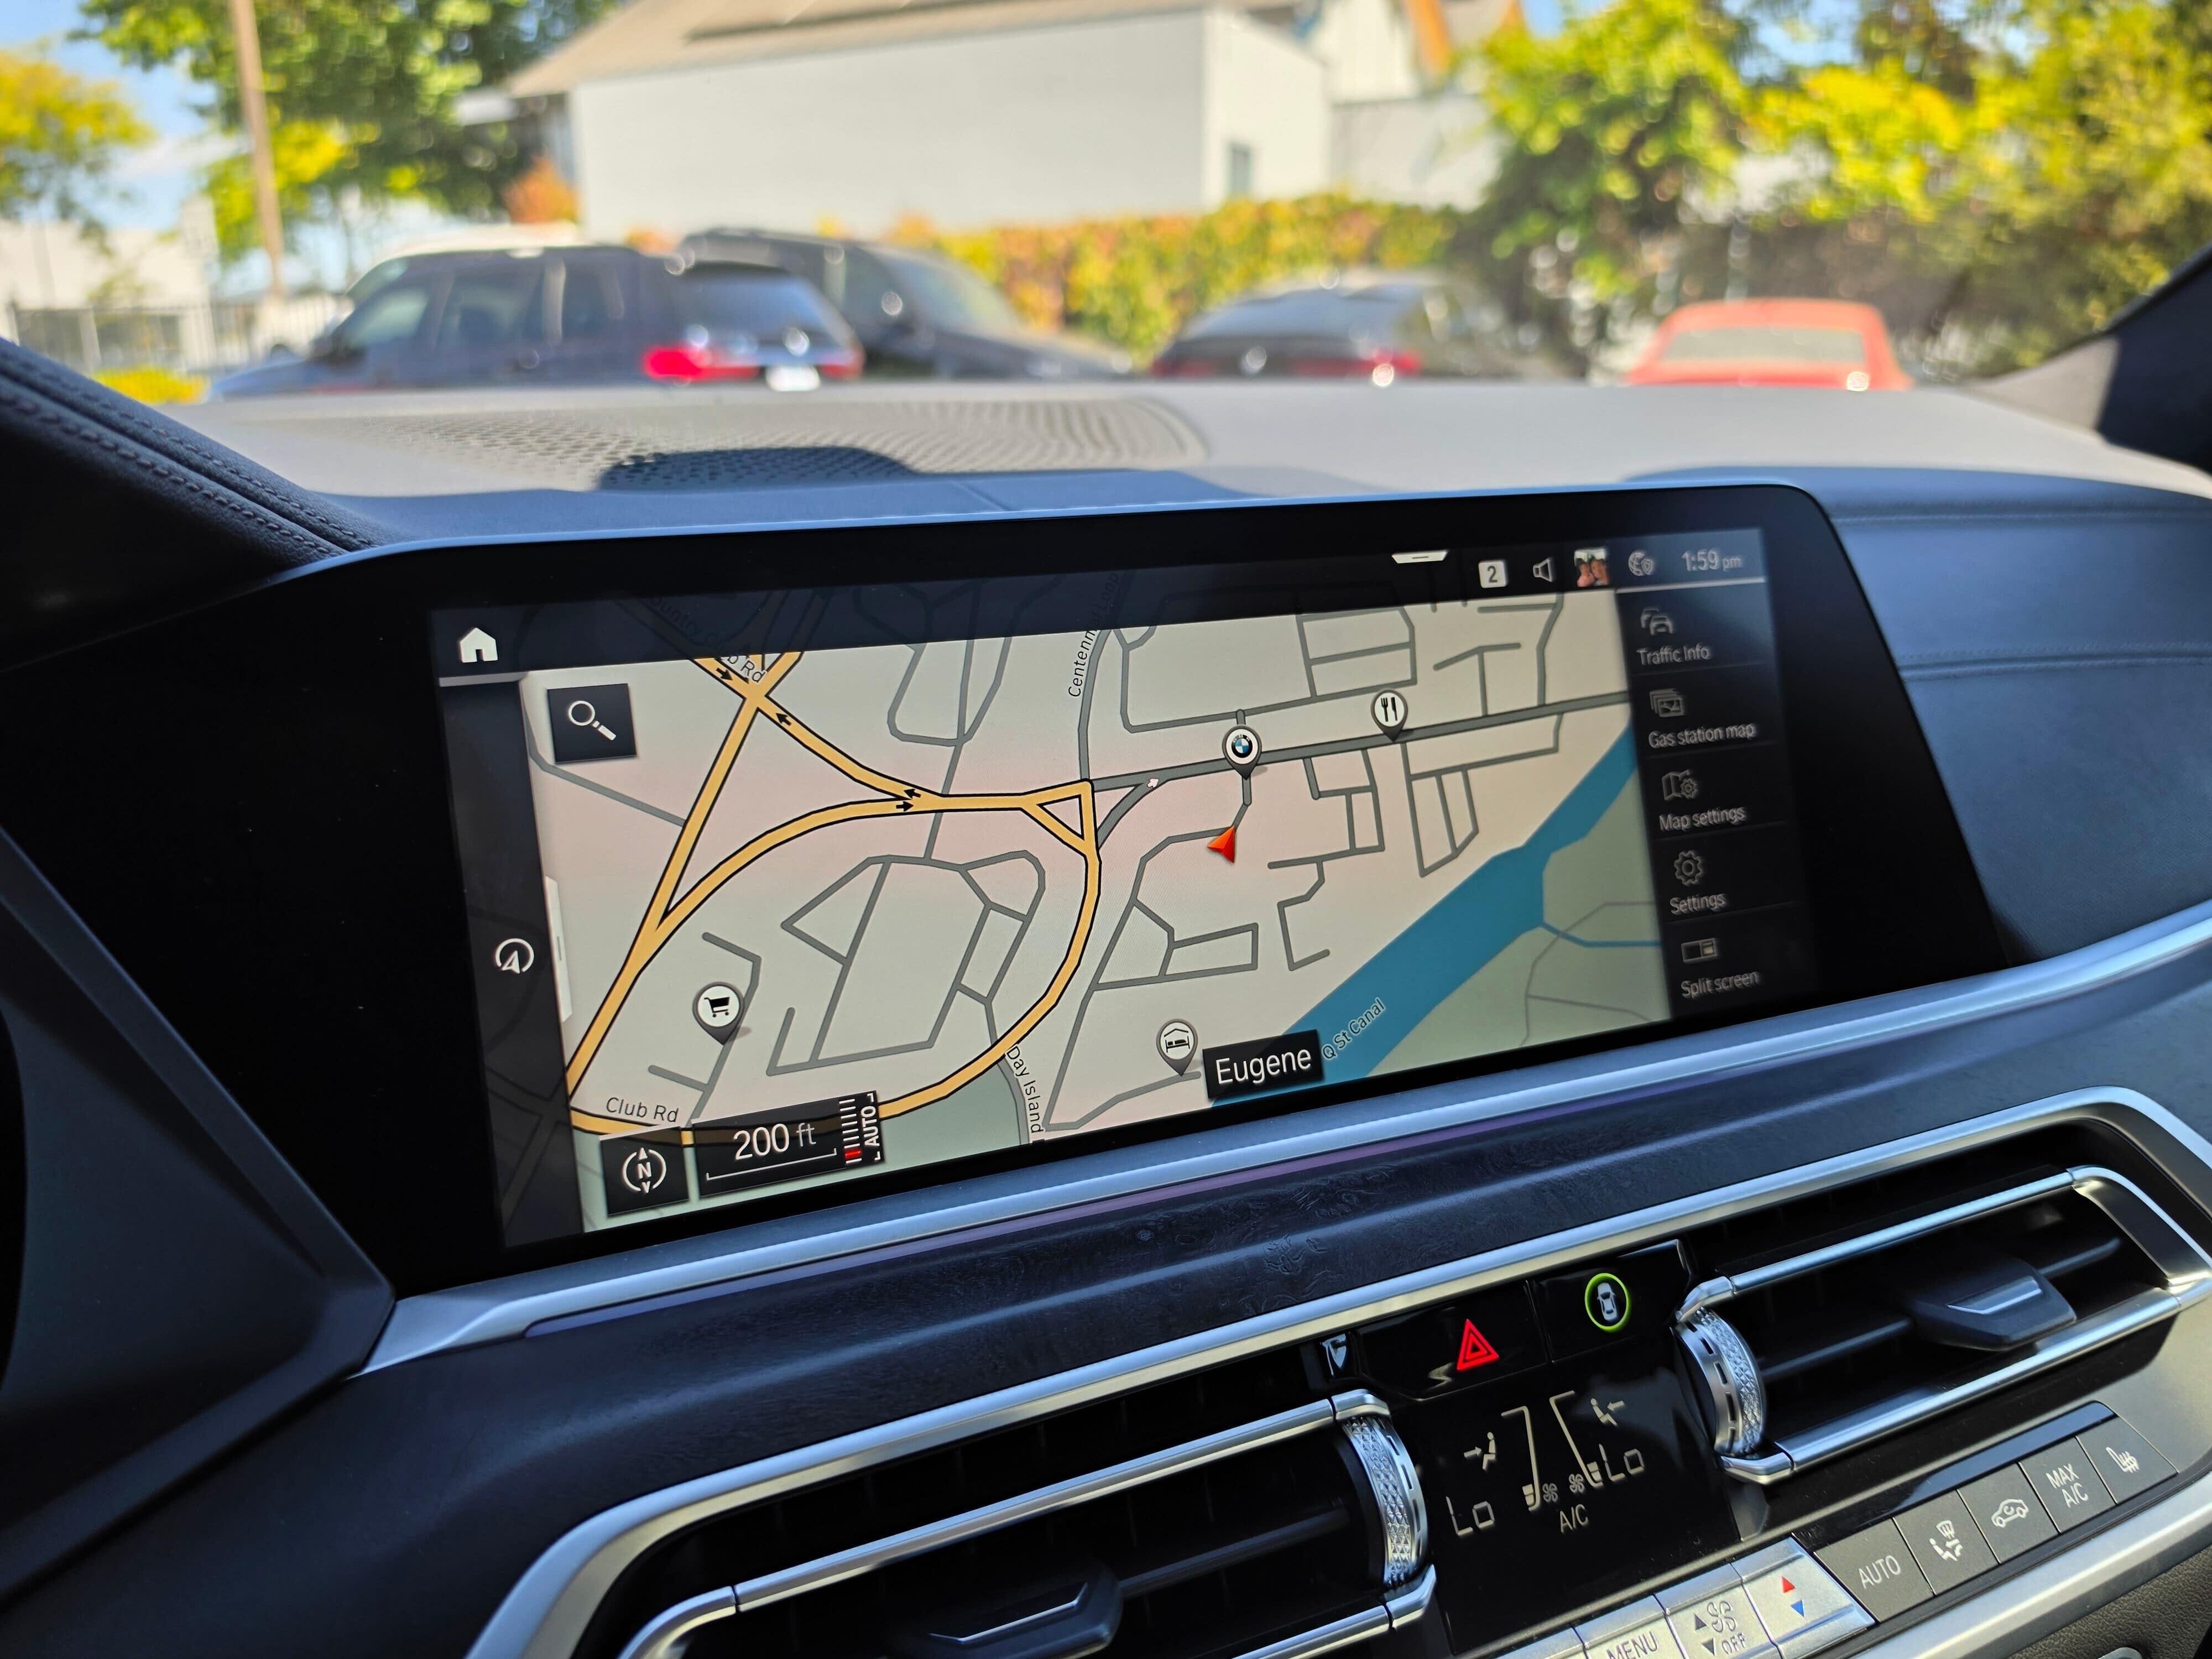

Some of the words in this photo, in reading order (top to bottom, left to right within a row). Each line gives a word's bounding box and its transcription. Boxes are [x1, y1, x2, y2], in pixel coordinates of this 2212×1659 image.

[1682, 549, 1719, 572] 1:59
[1723, 555, 1742, 572] pm
[1486, 565, 1498, 583] 2
[1636, 645, 1682, 665] Traffic
[1683, 643, 1712, 661] Info
[740, 660, 766, 684] Rd
[1648, 730, 1678, 749] Gas
[1677, 726, 1725, 745] station
[1725, 723, 1757, 740] map
[1658, 813, 1691, 832] Map
[1692, 806, 1747, 827] settings
[1670, 893, 1728, 915] Settings
[1681, 977, 1714, 1000] Split
[1714, 971, 1762, 993] screen
[1323, 1045, 1337, 1060] Q
[1334, 1031, 1351, 1049] St
[1349, 997, 1386, 1035] Canal
[1215, 1048, 1311, 1084] Eugene
[1006, 1046, 1030, 1077] Day
[1023, 1080, 1044, 1134] Island
[606, 1097, 648, 1118] Club
[653, 1105, 680, 1123] Rd
[860, 1105, 880, 1147] AUTO
[733, 1123, 790, 1161] 200
[796, 1122, 817, 1147] ft
[637, 1161, 652, 1179] N
[1598, 1443, 1645, 1482] Lo
[2045, 1463, 2080, 1489] MAX
[2062, 1483, 2089, 1508] A/C
[1446, 1496, 1495, 1537] Lo
[1558, 1504, 1589, 1533] A/C
[1858, 1554, 1901, 1589] AUTO
[1606, 1631, 1658, 1659] MENU
[1721, 1632, 1746, 1655] OFF
